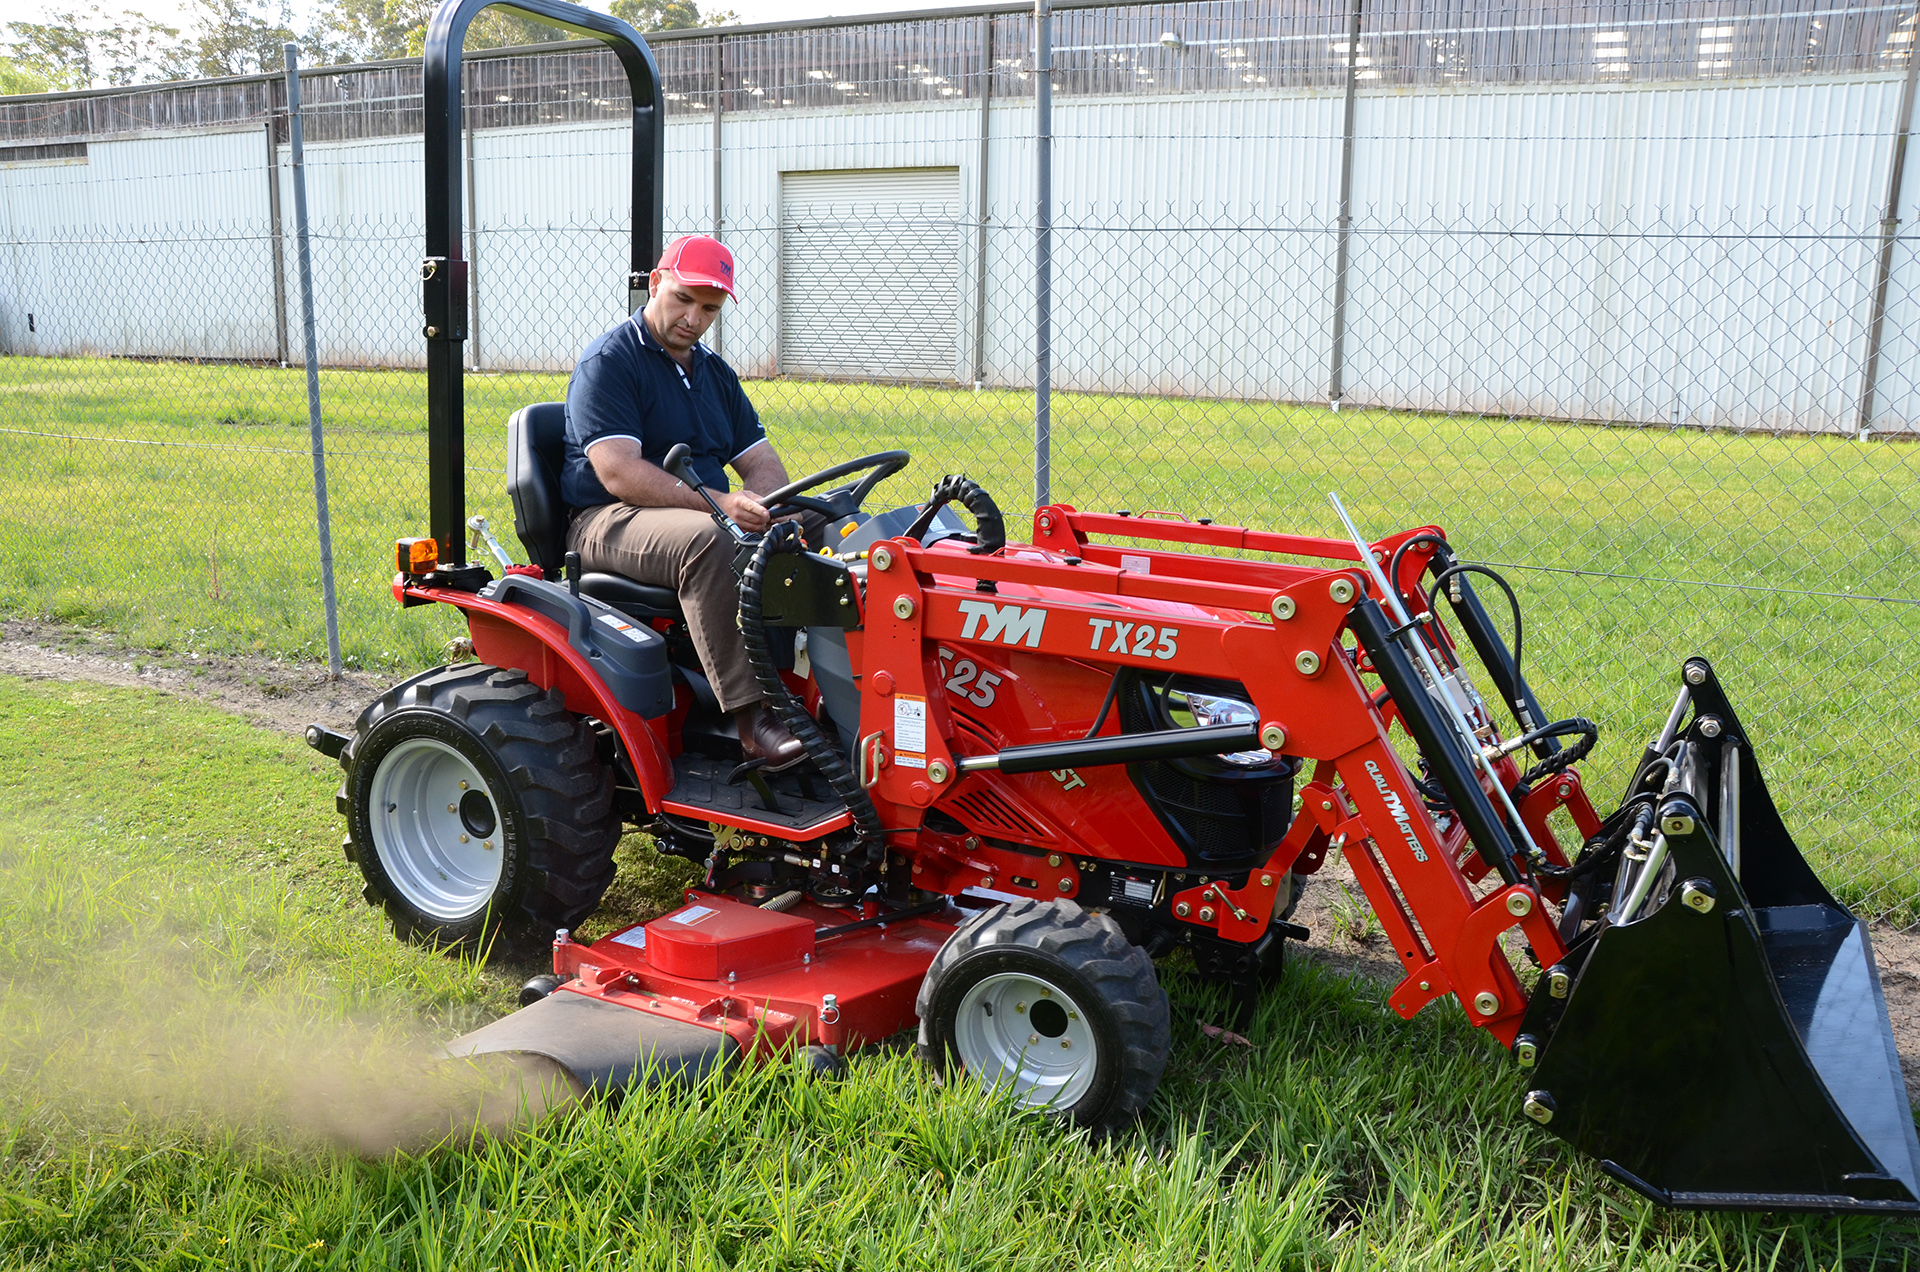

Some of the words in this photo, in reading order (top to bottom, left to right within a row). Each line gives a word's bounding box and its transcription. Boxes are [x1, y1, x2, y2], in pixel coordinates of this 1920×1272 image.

[957, 599, 1048, 648] TYM
[1088, 617, 1180, 660] TX25
[1049, 768, 1087, 792] ST
